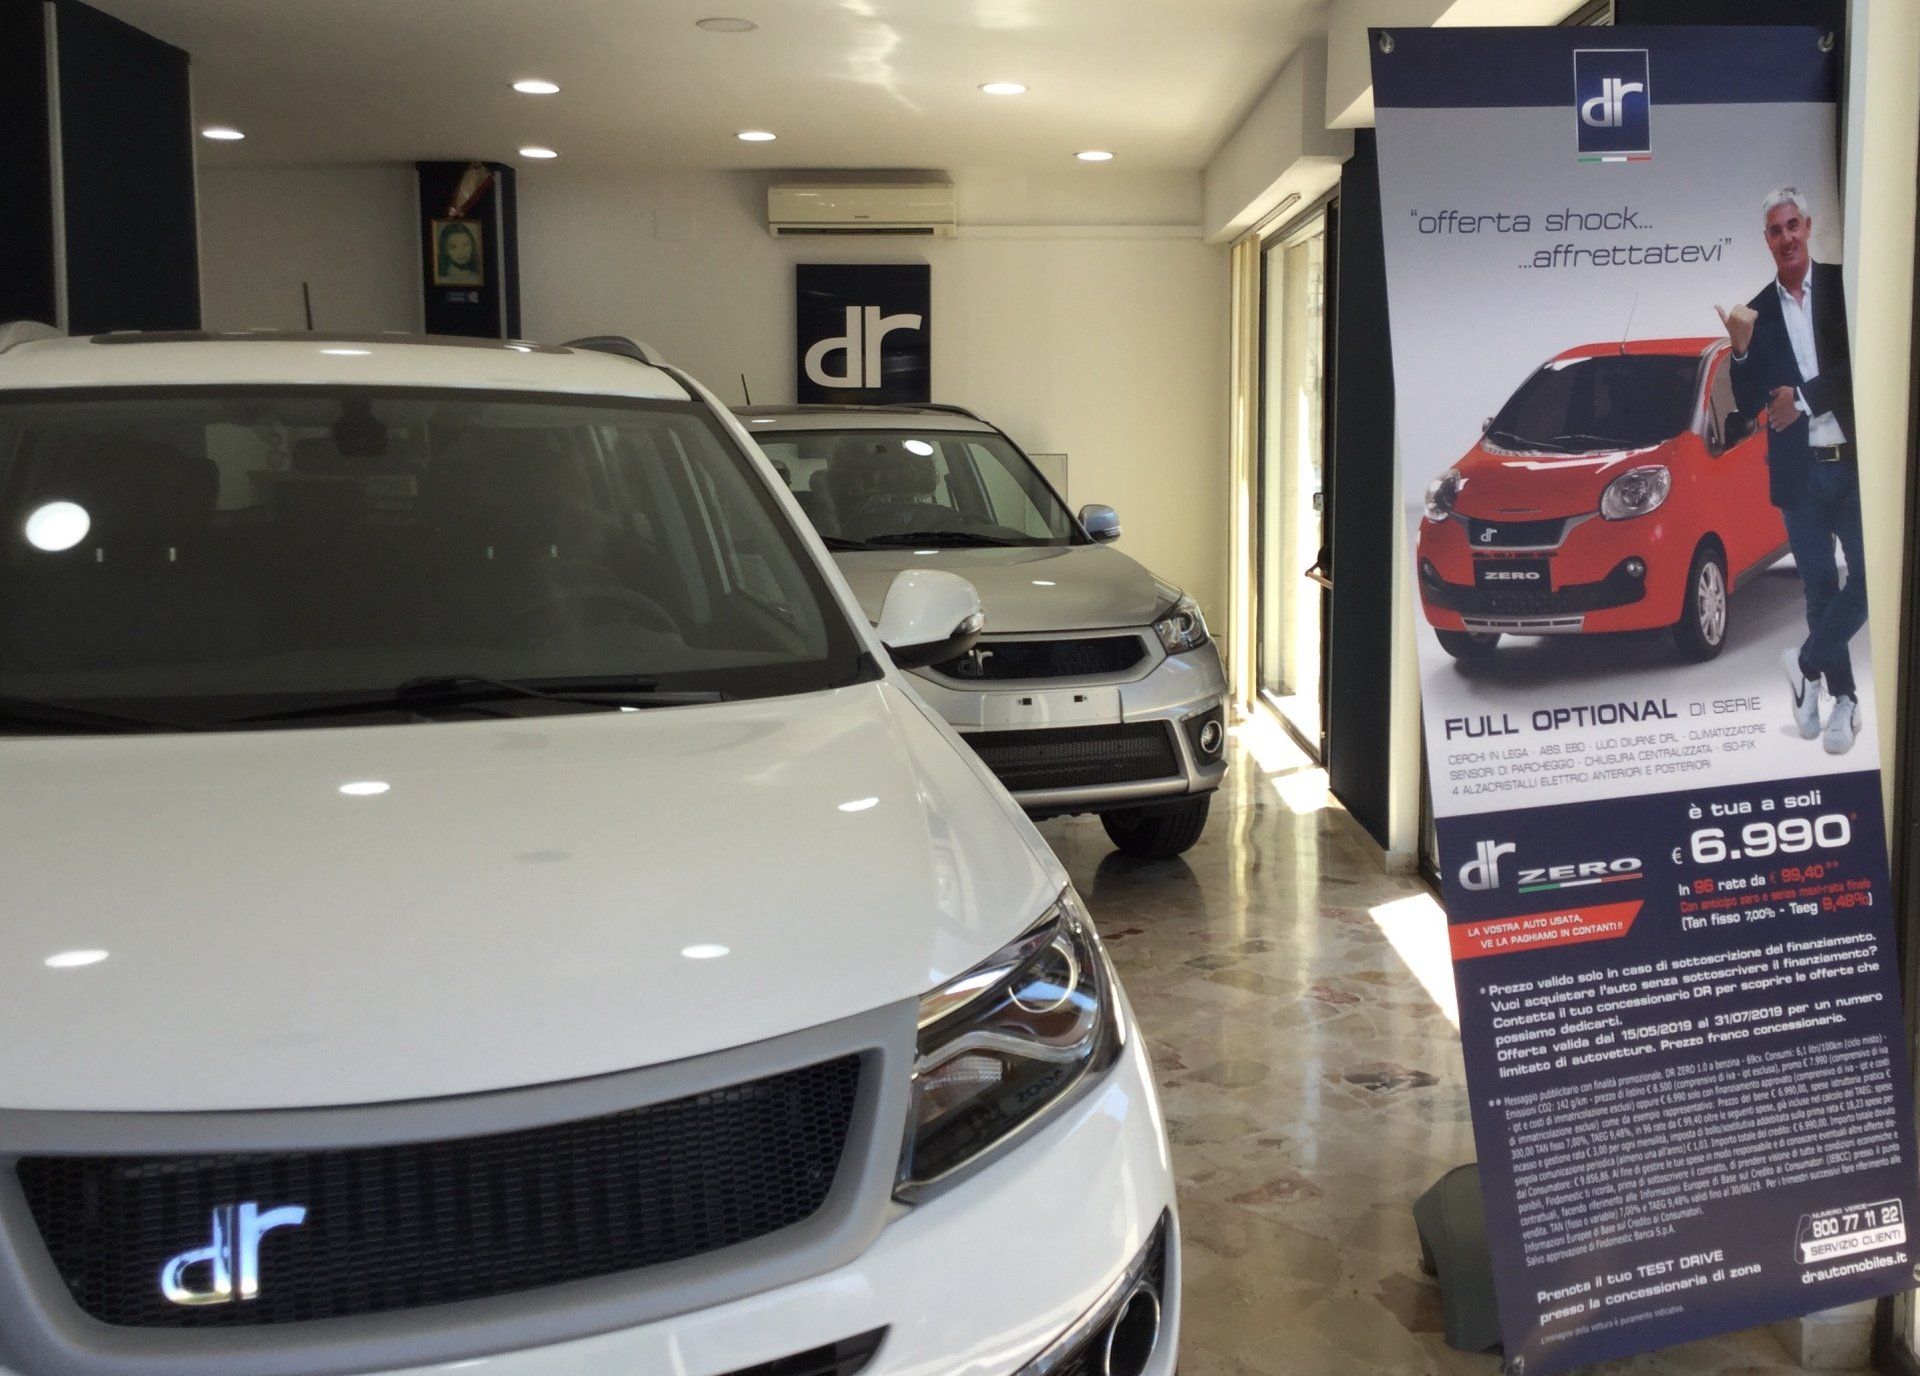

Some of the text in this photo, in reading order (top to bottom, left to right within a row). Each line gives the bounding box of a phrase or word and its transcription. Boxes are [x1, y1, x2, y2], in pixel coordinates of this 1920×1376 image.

[1581, 78, 1643, 127] dr
[804, 305, 922, 389] dr
[1485, 571, 1541, 580] ZERO
[1444, 698, 1678, 740] FULL OPTIONAL
[1689, 696, 1761, 717] DI SERIE
[1447, 752, 1487, 766] CERCHI
[1488, 750, 1500, 761] IN
[1501, 747, 1529, 760] LEGA
[1564, 741, 1586, 754] EBD
[1595, 738, 1618, 751] LUCI
[1658, 732, 1679, 744] DRL
[1688, 723, 1766, 741] CLIMATIZZATORE
[1448, 739, 1756, 781] SENSORI DI PARCHEGGIO CHIUSURA CENTRALIZZATA ISO-FIX
[1451, 759, 1711, 796] 4 ALZACRISTALLI ELETTRICI ANTERIORI E POSTERIORI
[1688, 789, 1822, 819] è tua a soli
[1458, 839, 1516, 890] dr
[1518, 857, 1642, 884] ZERO
[1672, 847, 1683, 865] €
[1678, 883, 1690, 896] In
[1718, 878, 1747, 891] rate
[1750, 874, 1766, 888] da
[1468, 914, 1583, 937] LA VOSTRA AUTO USATA,
[1680, 901, 1698, 913] Con
[1681, 915, 1708, 931] (Tan
[1711, 912, 1741, 927] fisso
[1744, 907, 1776, 924] 7,00%
[1789, 901, 1819, 915] Taeg
[1480, 939, 1494, 949] VE
[1496, 937, 1509, 946] LA
[1511, 930, 1558, 945] PAGHIAMO
[1560, 928, 1570, 938] IN
[1488, 932, 1876, 996] Prezzo valido solo in caso di sottoscrizione del finanziamento.
[1490, 944, 1878, 1012] Vuoi acquistare l'auto senza sottoscrivere il finanziamento?
[1492, 961, 1880, 1029] Contatta il tuo concessionario DR per scoprire le offerte che
[1494, 1014, 1623, 1048] possiamo dedicarti.
[1496, 992, 1883, 1062] Offerta valida dal 15/05/2019 al 31/07/2019 per un numero
[1499, 1012, 1846, 1078] limitato di autovetture. Prezzo franco concessionario.
[1812, 1205, 1899, 1238] 800 77 11 22
[160, 1202, 308, 1306] dr
[1810, 1229, 1901, 1256] SERVIZIO CLIENTI
[1536, 1248, 1724, 1304] Prenota il tuo TEST DRIVE
[1801, 1251, 1908, 1284] drautomobiles.it
[1539, 1263, 1762, 1326] presso la concessionaria di zona
